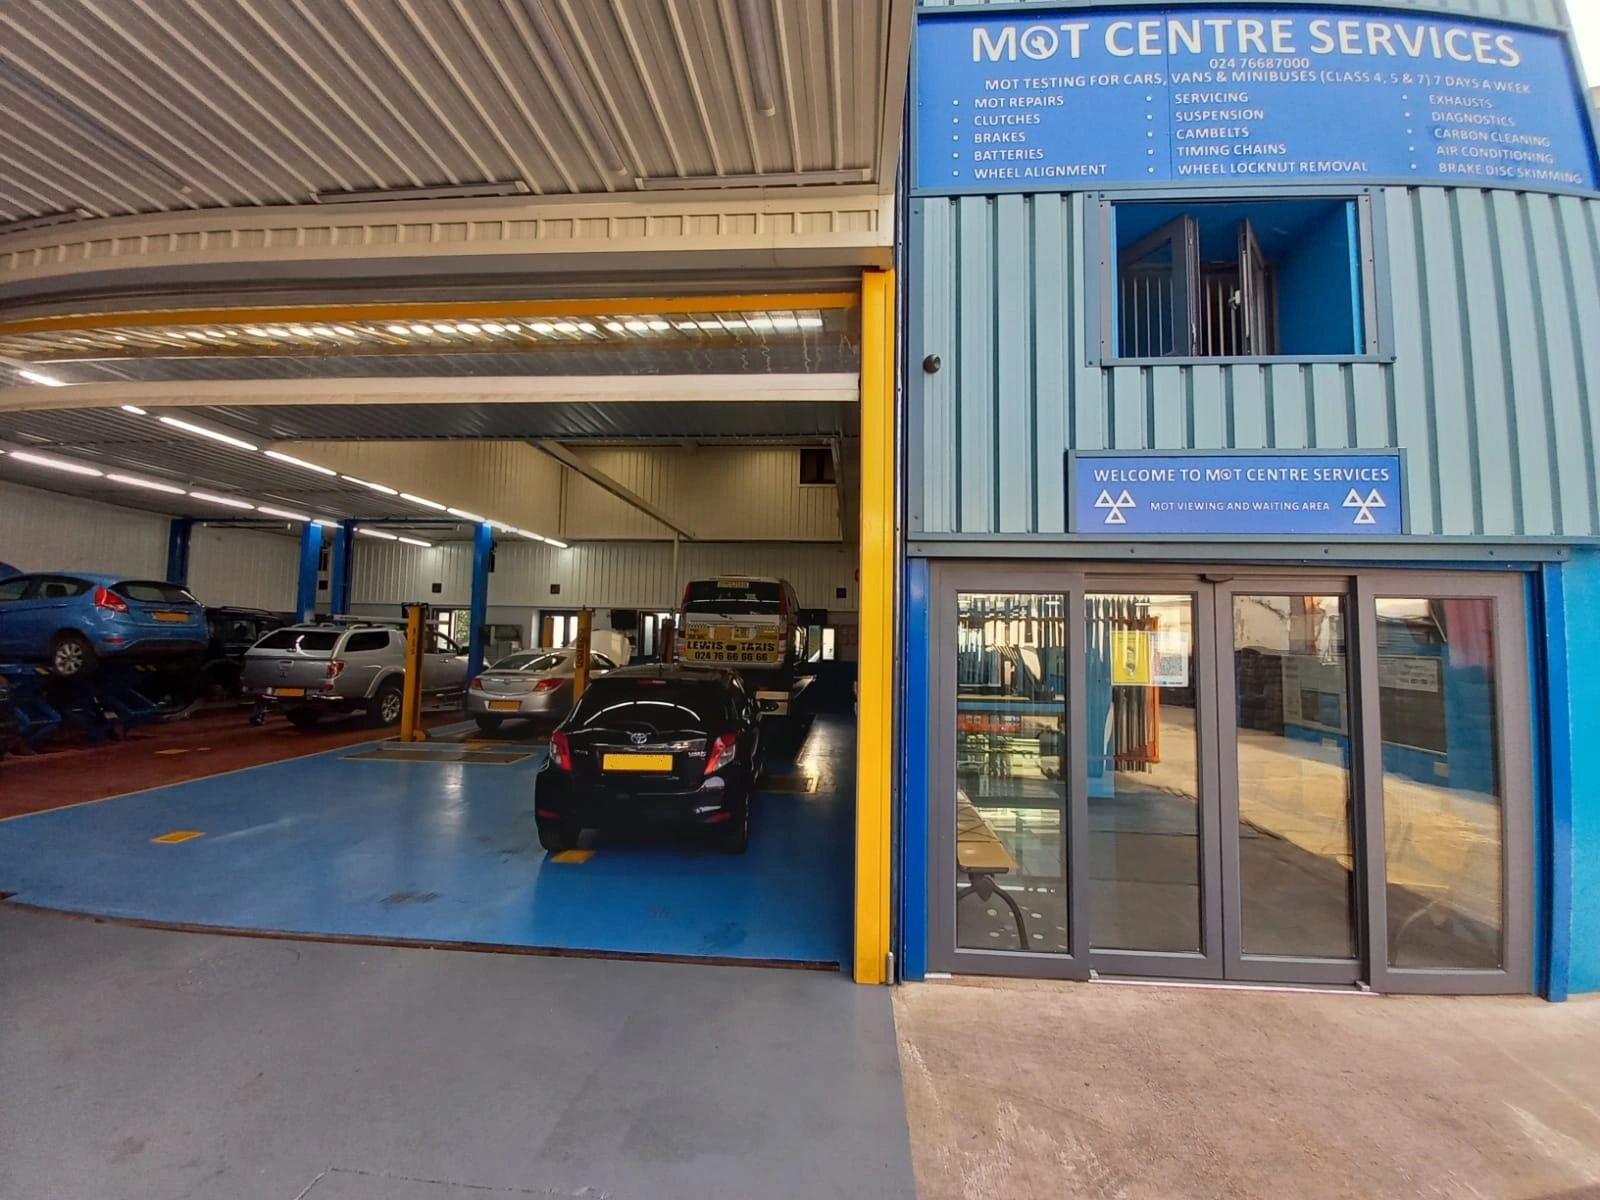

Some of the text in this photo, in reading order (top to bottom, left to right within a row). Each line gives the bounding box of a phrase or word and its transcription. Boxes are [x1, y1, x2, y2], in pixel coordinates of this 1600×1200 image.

[972, 19, 1521, 67] MOT CENTRE SERVICES
[1209, 57, 1310, 70] 024 76687000
[985, 69, 1532, 95] MOT TESTING FOR CARS, VANS & MINIBUSES (CLASS 4, 5 & 7) 7 DAYS A WEEK
[974, 95, 1065, 110] MOT REPAIRS
[1174, 91, 1250, 105] SERVICING
[1428, 94, 1494, 110] EXHAUSTS
[973, 113, 1041, 127] CLUTCHES
[1175, 108, 1265, 122] SUSPENSION
[1431, 111, 1516, 127] DIAGNOSTICS
[973, 131, 1027, 145] BRAKES
[1175, 126, 1250, 141] CAMBELTS
[1433, 127, 1551, 148] CARBON CLEANING
[973, 148, 1045, 162] BATTERIES
[1177, 143, 1288, 158] TIMING CHAINS
[1436, 145, 1554, 164] AIR CONDITIONING
[973, 163, 1108, 180] WHEEL ALIGNMENT
[1178, 160, 1369, 176] WHEEL LOCKNUT REMOVAL
[1439, 162, 1584, 185] BRAKE DISC SKIMMING
[1094, 467, 1390, 482] WELCOME TO MOT CENTRE SERVICES
[1150, 501, 1330, 512] MOT VIEWING AND WAITING AREA
[687, 640, 775, 653] LEWIS TAXIS
[694, 651, 712, 661] 024
[713, 651, 725, 661] 76
